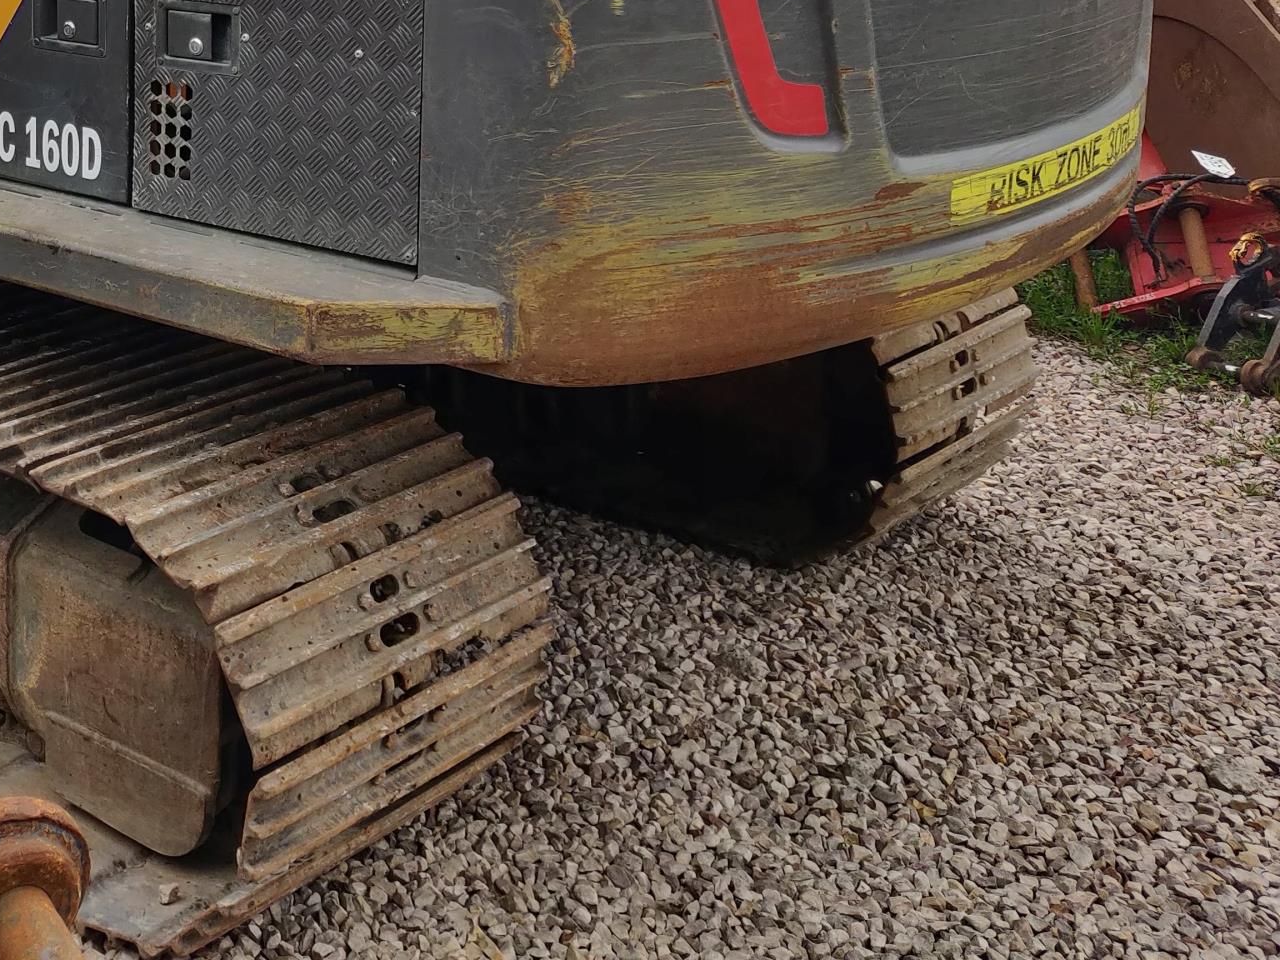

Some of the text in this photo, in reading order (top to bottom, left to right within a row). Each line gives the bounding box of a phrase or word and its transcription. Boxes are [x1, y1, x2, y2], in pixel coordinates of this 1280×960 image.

[25, 116, 102, 180] 160D
[989, 162, 1046, 206] RISK
[1055, 135, 1102, 185] ZONE
